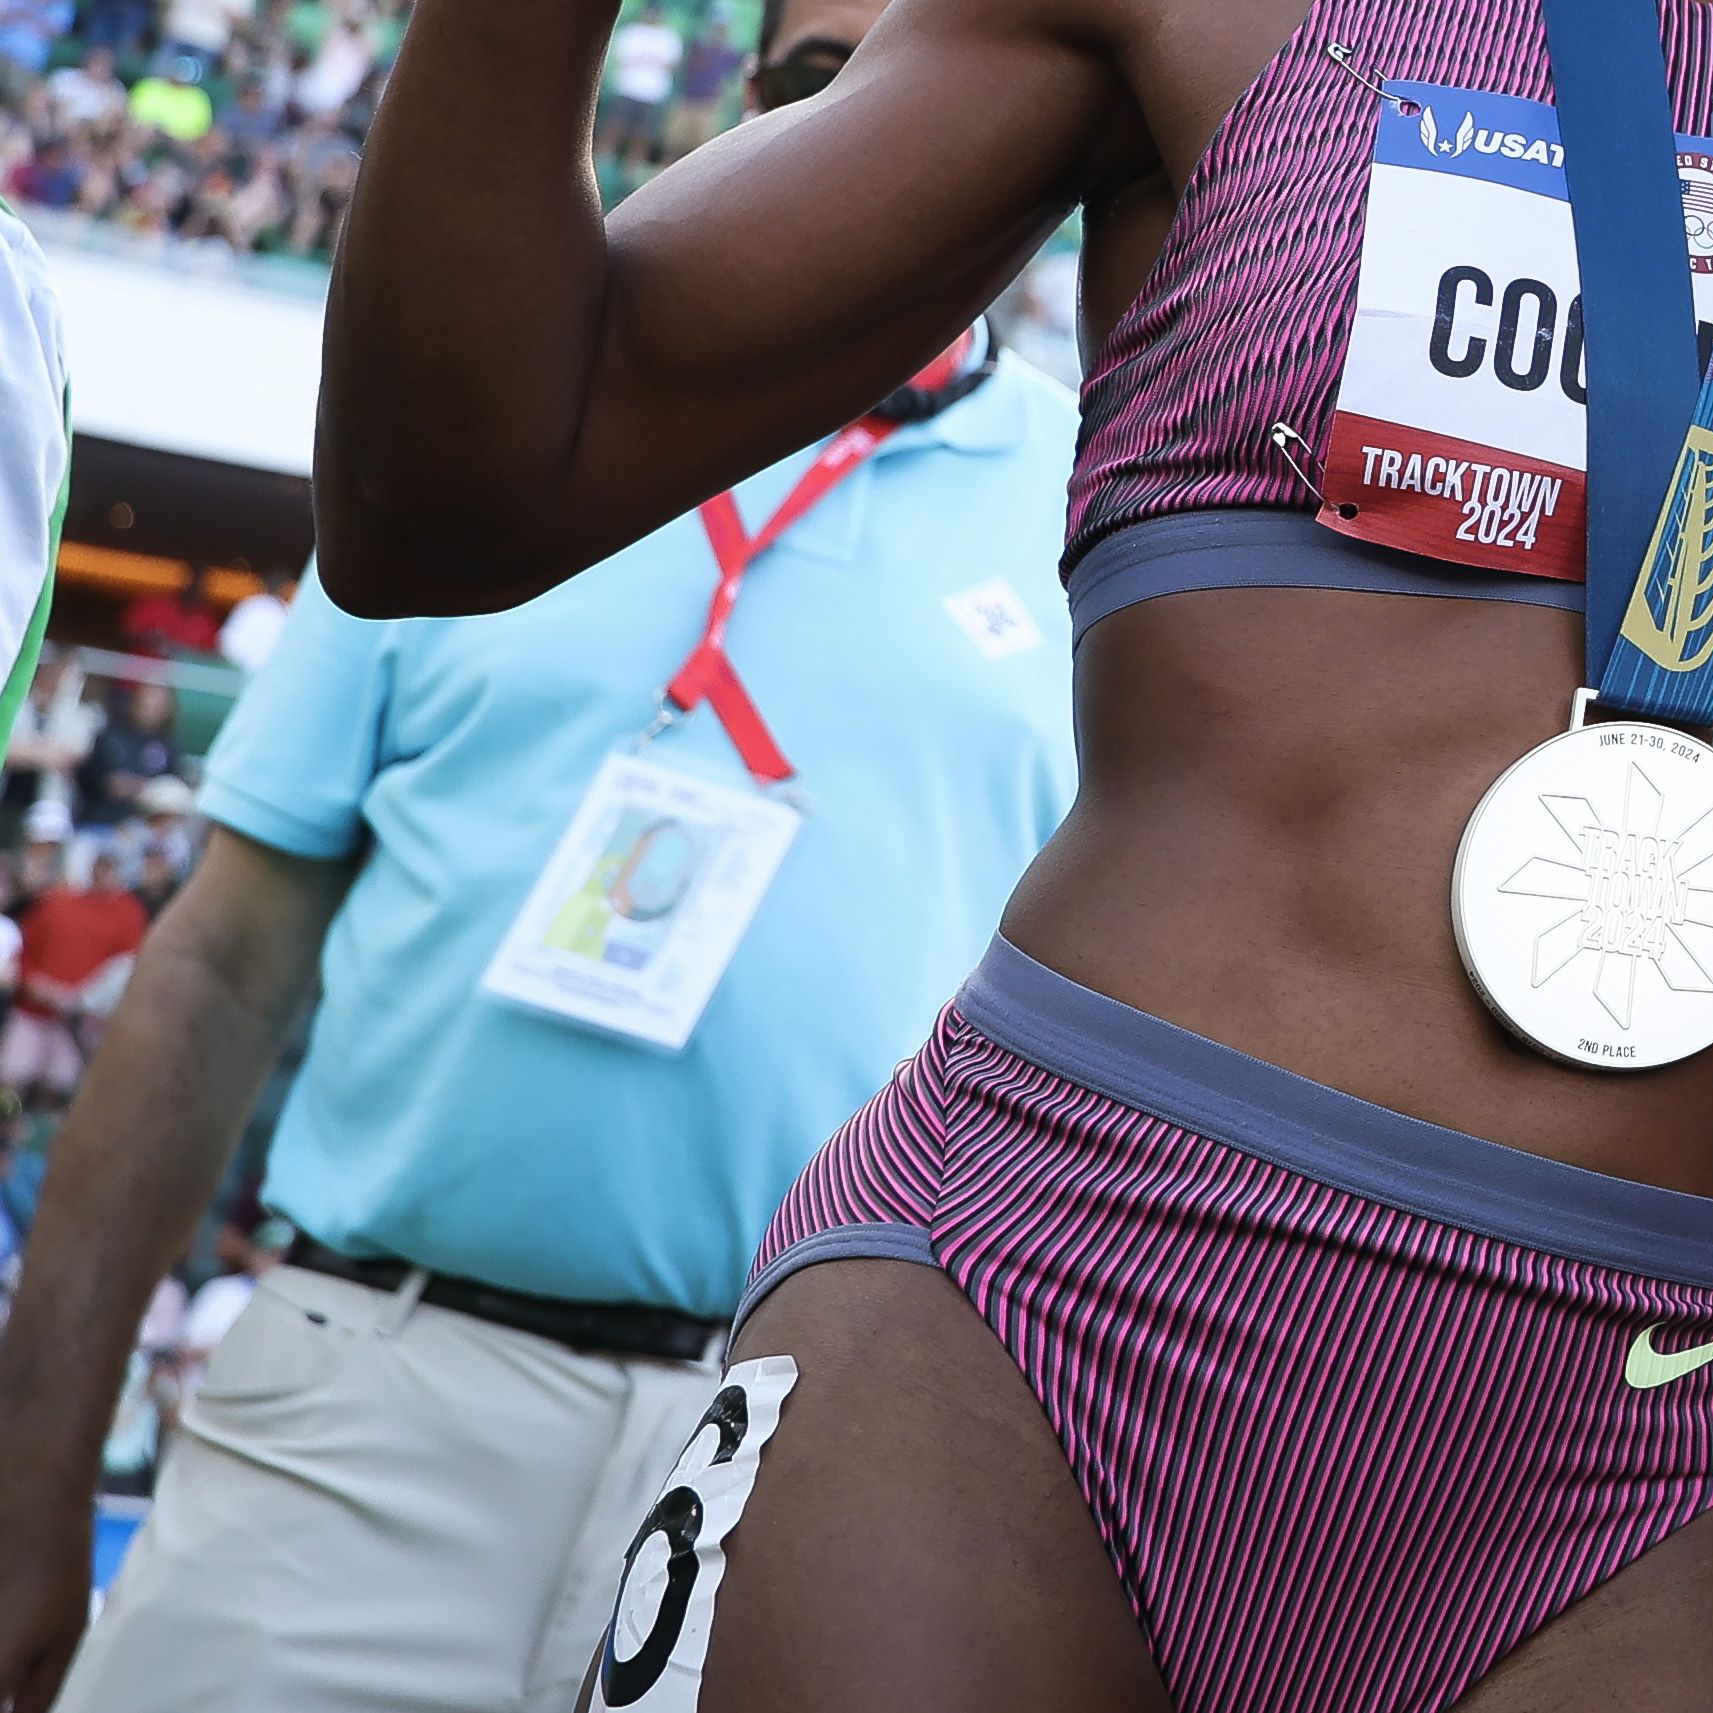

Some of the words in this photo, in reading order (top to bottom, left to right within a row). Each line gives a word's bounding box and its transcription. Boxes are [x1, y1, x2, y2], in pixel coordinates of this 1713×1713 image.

[1474, 128, 1565, 168] USAT
[1361, 446, 1562, 517] TRACKTOWN
[1455, 500, 1537, 550] 2024
[1599, 733, 1625, 747] JUNE
[1630, 733, 1666, 751] 21-30,
[1670, 742, 1701, 764] 2024
[1577, 904, 1668, 962] 2024
[1577, 1038, 1599, 1054] 2ND
[1602, 1045, 1636, 1058] PLACE
